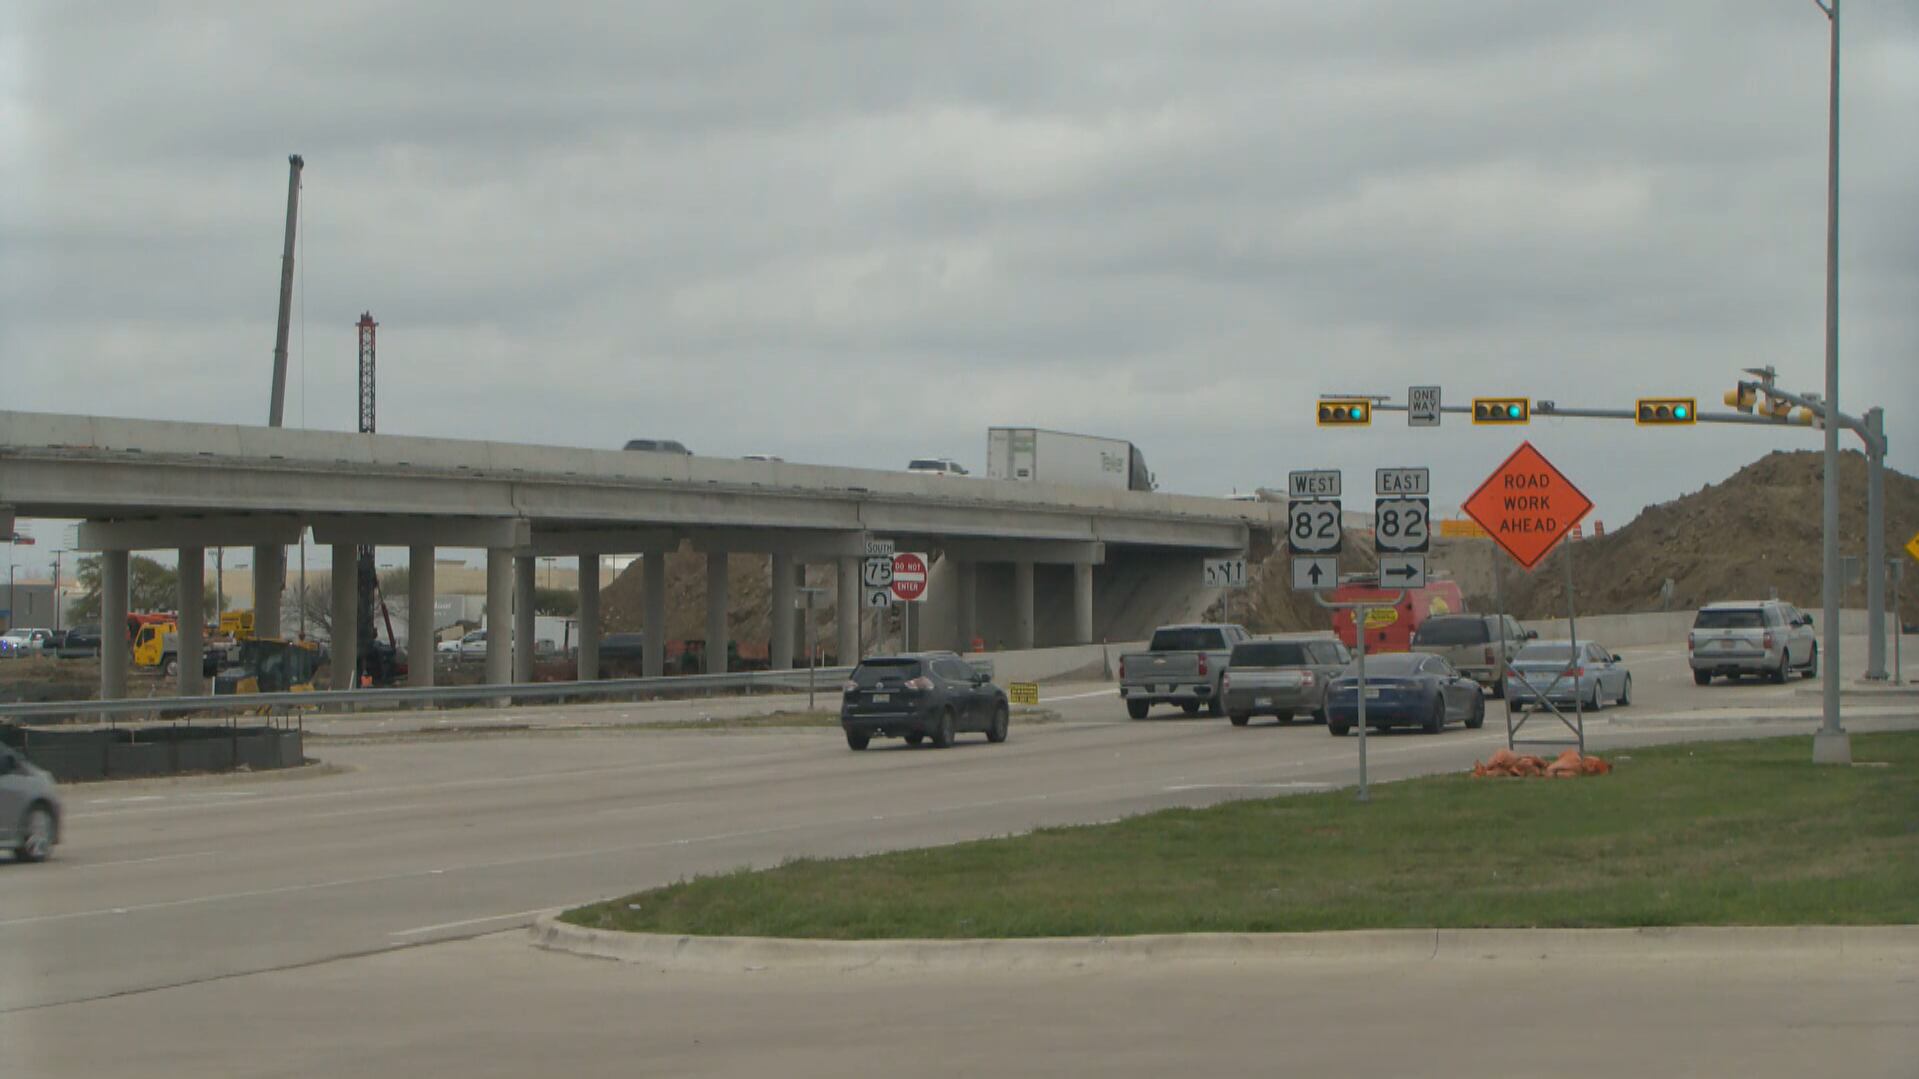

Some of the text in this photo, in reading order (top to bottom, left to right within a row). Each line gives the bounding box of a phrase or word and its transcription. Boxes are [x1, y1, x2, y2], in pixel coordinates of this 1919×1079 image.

[1413, 390, 1436, 400] ONE
[1413, 401, 1436, 411] WAY
[1295, 476, 1334, 493] WEST
[1383, 473, 1421, 491] EAST
[1504, 474, 1550, 489] ROAD
[1503, 496, 1550, 511] WORK
[1295, 512, 1335, 539] 82
[1382, 509, 1422, 537] 82
[1500, 518, 1557, 533] AHEAD
[867, 542, 892, 553] SOUTH
[868, 562, 891, 580] 75
[895, 562, 921, 572] DO NOT
[897, 582, 918, 592] ENTER
